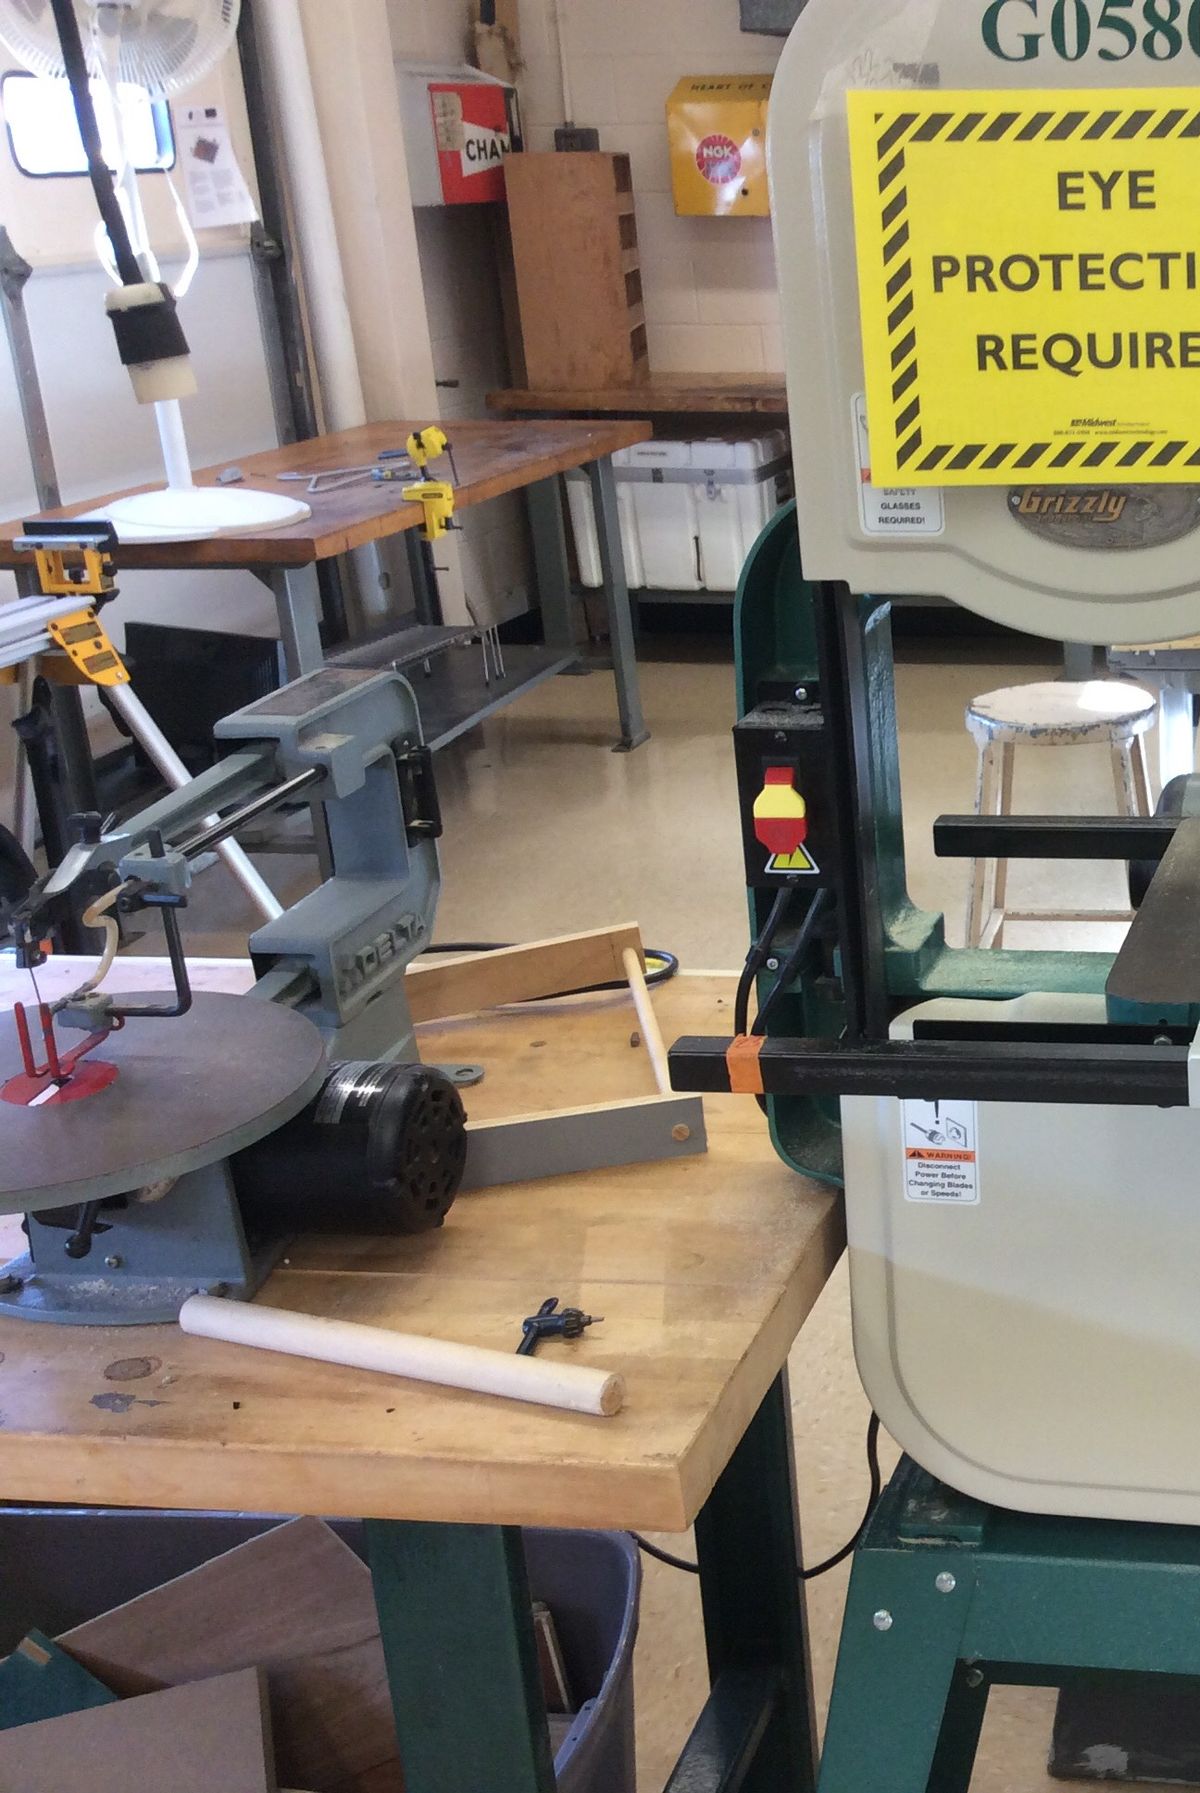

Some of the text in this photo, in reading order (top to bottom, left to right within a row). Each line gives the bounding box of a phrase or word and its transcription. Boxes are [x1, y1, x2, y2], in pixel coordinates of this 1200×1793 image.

[703, 144, 733, 159] NGK
[1057, 170, 1156, 211] EYE
[880, 502, 921, 510] GLASSES
[1018, 488, 1127, 522] Grizzly
[355, 911, 427, 979] DELTA
[918, 1162, 961, 1170] Disconnect
[941, 1172, 966, 1180] Before
[909, 1180, 973, 1189] Changing Blades
